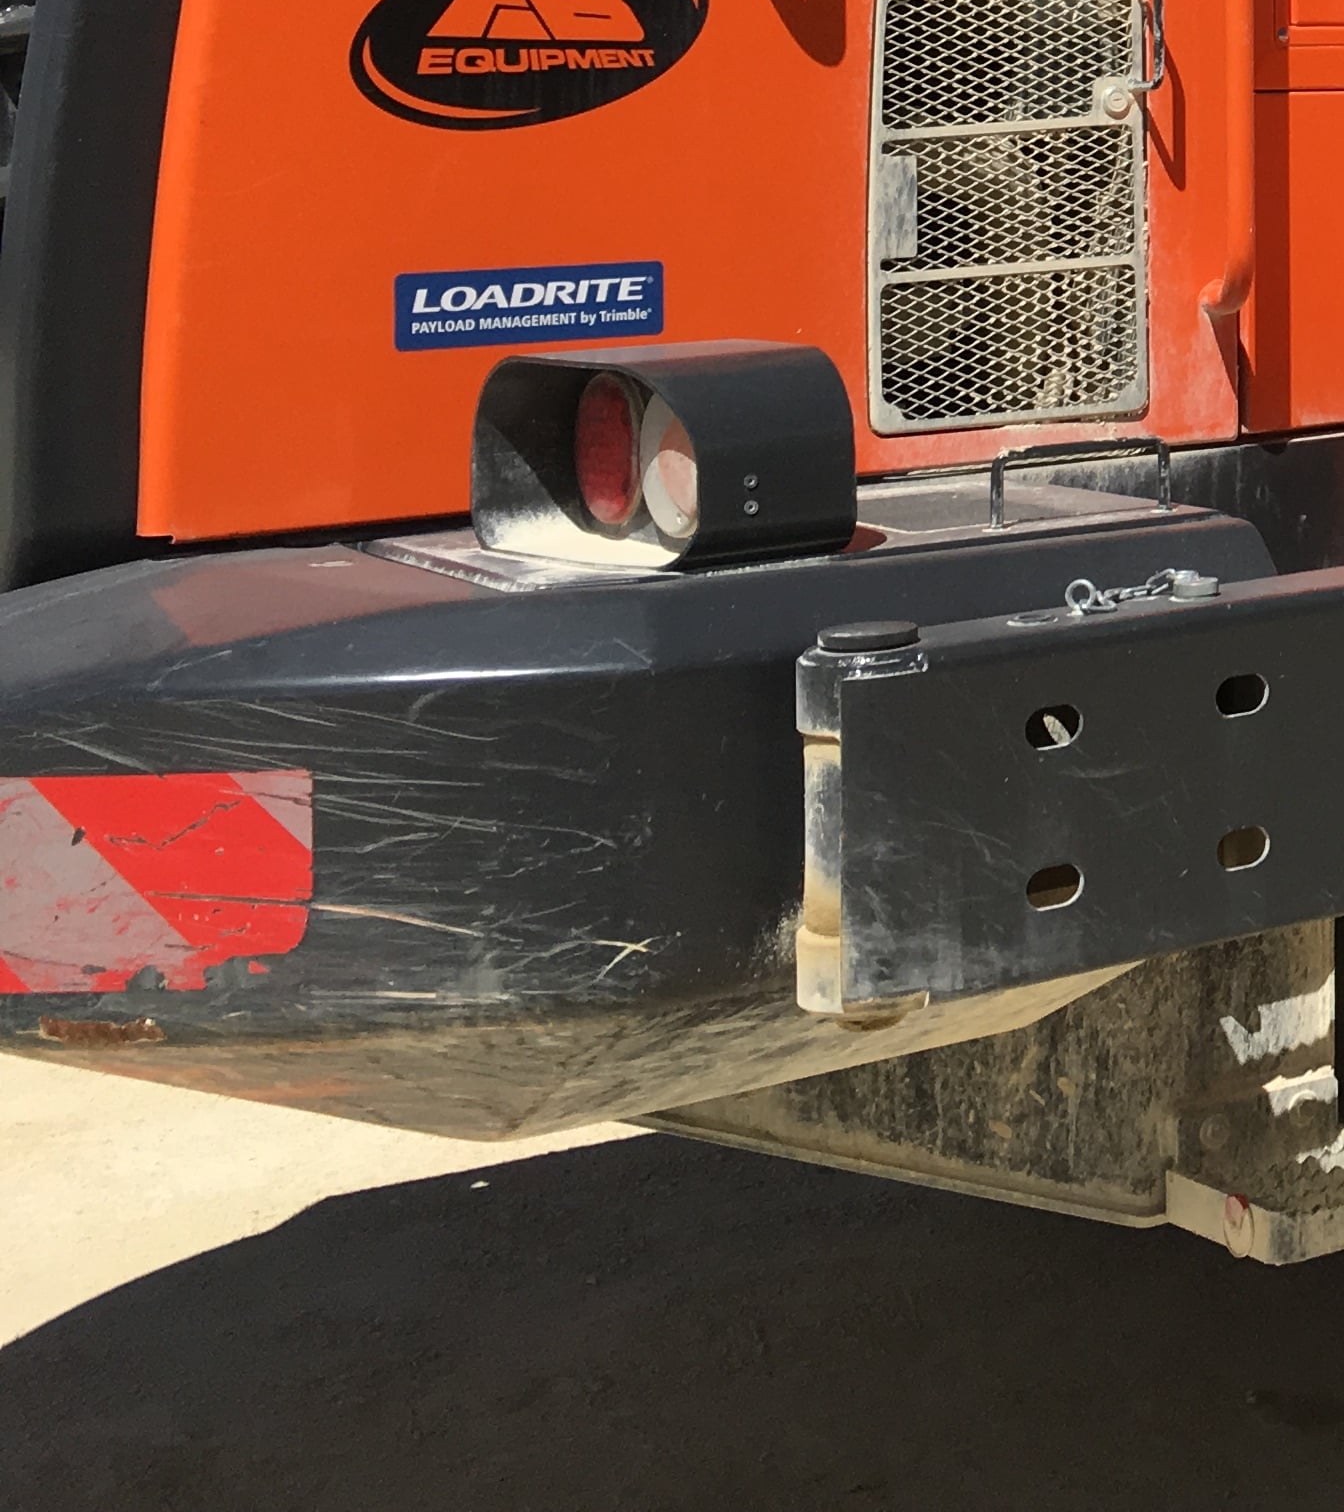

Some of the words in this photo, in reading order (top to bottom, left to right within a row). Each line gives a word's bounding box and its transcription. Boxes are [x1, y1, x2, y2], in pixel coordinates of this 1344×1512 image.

[416, 47, 656, 75] EQUIPMENT
[411, 318, 476, 335] PAYLOAD
[479, 312, 577, 330] MANAGEMENT
[580, 311, 597, 326] by
